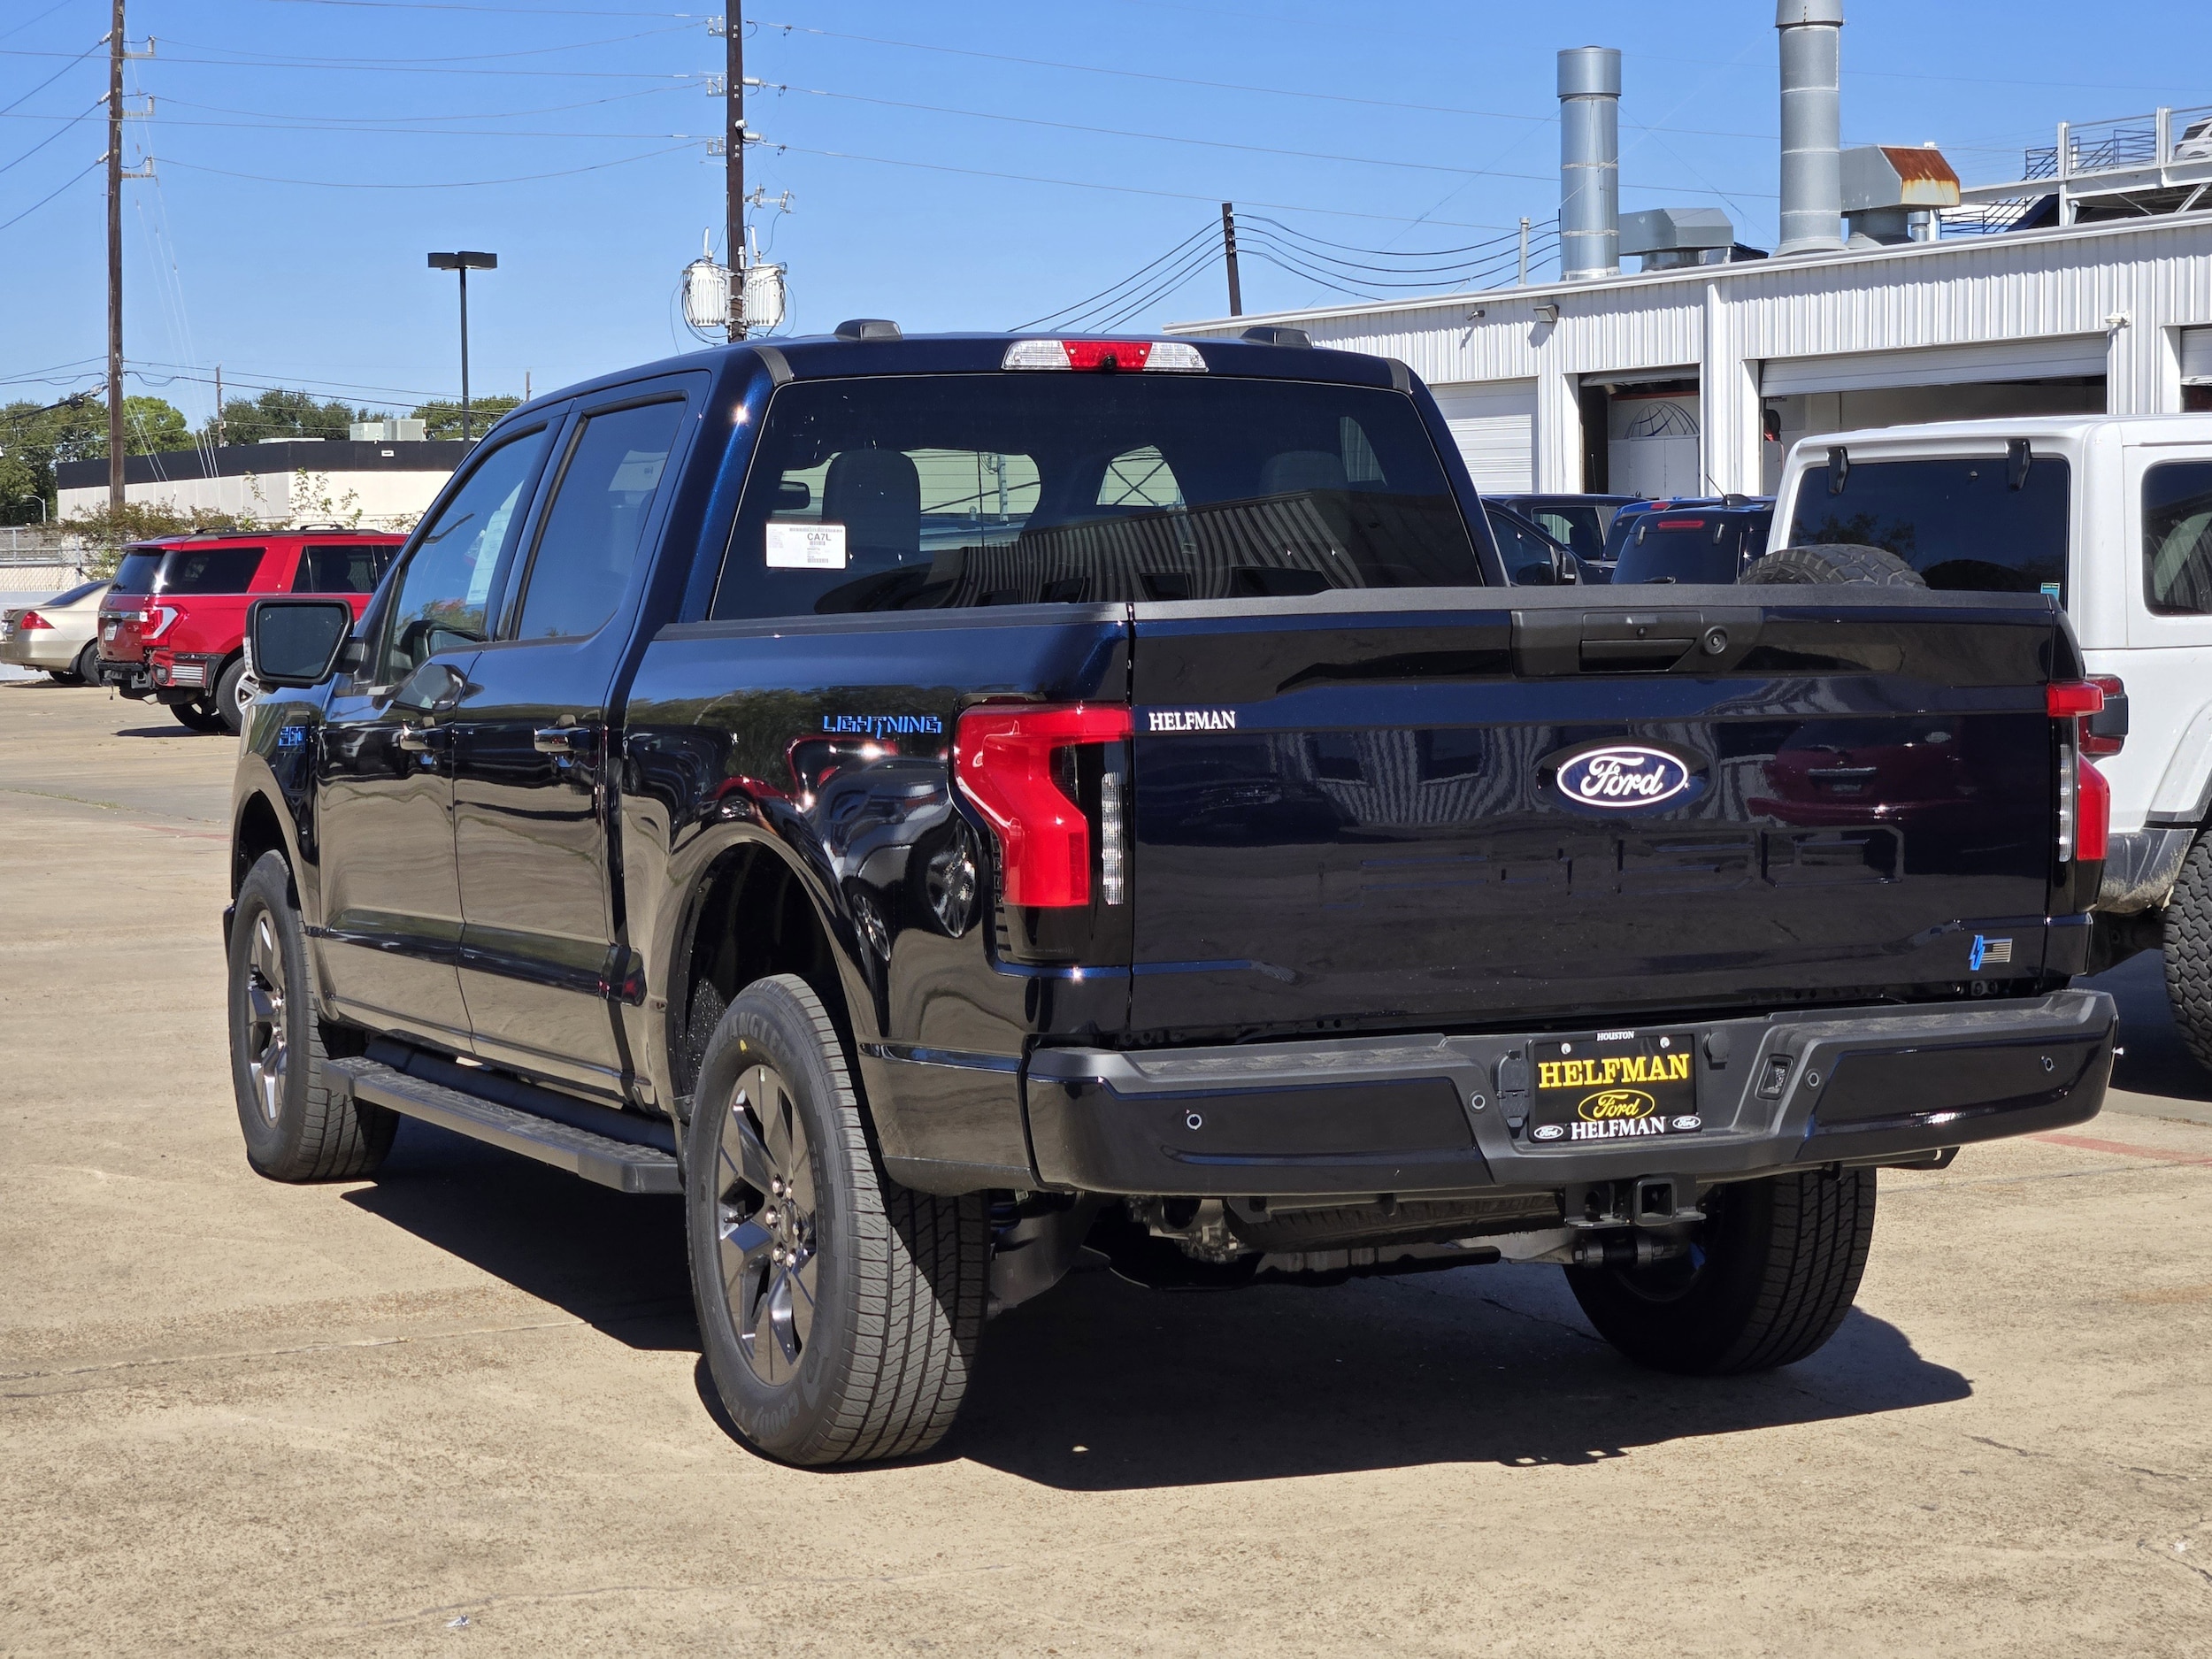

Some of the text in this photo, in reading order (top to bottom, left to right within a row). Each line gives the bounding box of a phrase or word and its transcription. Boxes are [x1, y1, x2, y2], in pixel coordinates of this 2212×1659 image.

[822, 715, 942, 740] LIGHTNING
[1148, 710, 1236, 731] HELFMAN
[1580, 756, 1665, 796] Ford
[1596, 1030, 1635, 1042] HOUSTON
[1538, 1053, 1690, 1088] HELFMAN
[1593, 1094, 1640, 1118] Ford
[1570, 1116, 1667, 1141] HELFMAN
